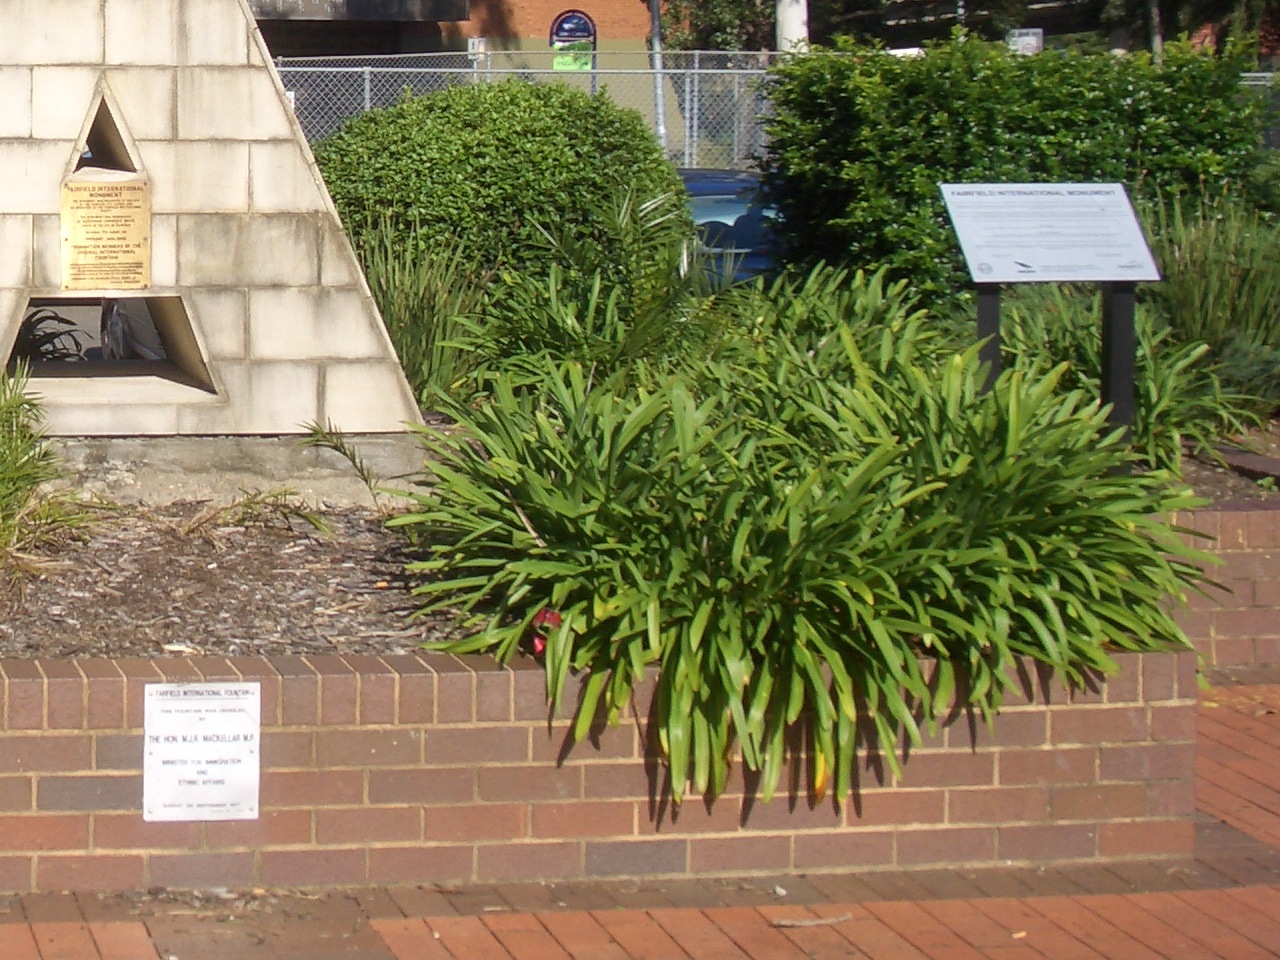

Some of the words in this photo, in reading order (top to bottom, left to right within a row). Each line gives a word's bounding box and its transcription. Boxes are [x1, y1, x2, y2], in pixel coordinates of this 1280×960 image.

[183, 689, 222, 697] INTERNATIONAL
[224, 689, 251, 697] FOUNTAIN
[149, 735, 161, 744] THE
